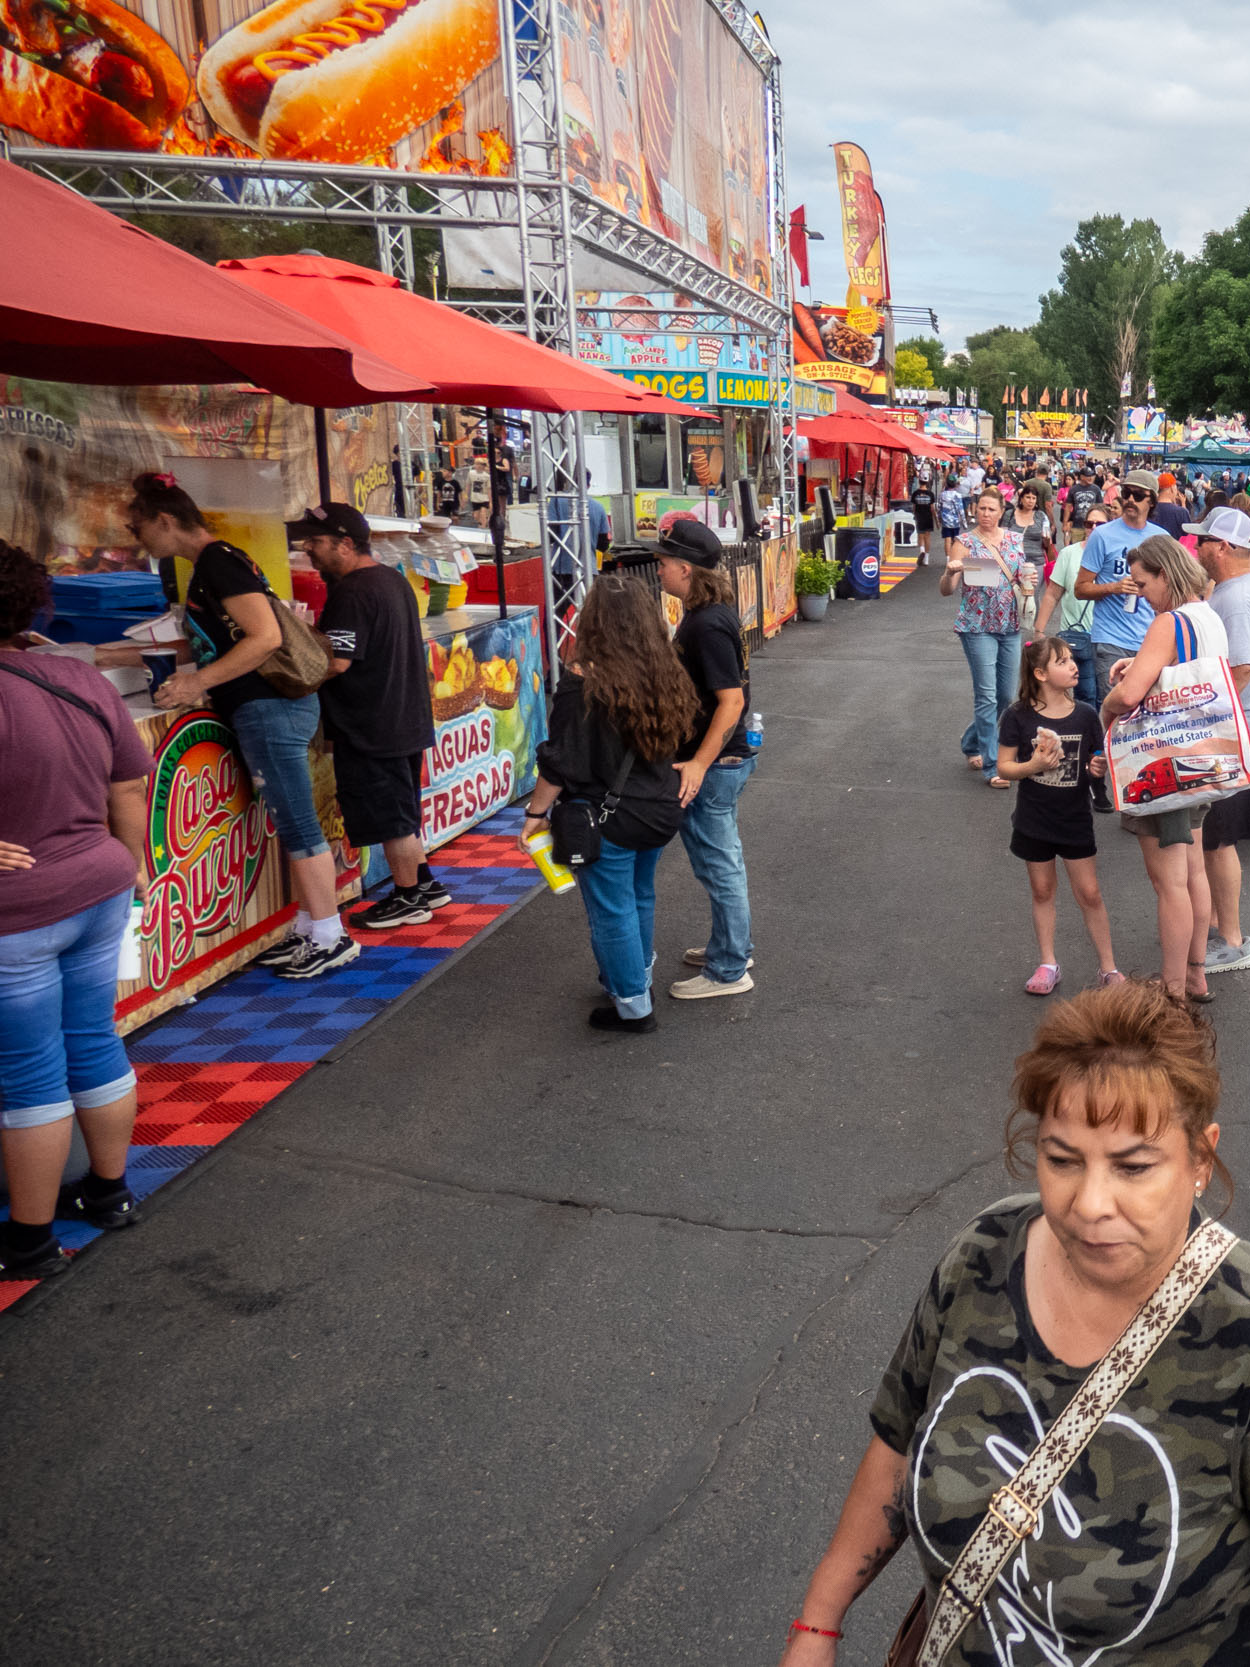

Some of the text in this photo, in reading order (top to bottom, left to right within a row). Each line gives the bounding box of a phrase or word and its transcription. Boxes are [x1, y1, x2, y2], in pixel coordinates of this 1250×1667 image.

[839, 150, 860, 258] TURKEY
[849, 266, 881, 287] LEGS
[644, 347, 665, 355] CANDY
[697, 338, 723, 349] BACON
[578, 351, 611, 362] NANAS
[631, 354, 669, 365] APPLES
[803, 364, 857, 375] SAUSAGE
[806, 371, 853, 381] ON-A-STICK
[7, 407, 77, 450] FRESCAS
[1035, 412, 1069, 421] CHICKEN
[354, 462, 389, 514] Cheetos
[1145, 682, 1214, 707] merican
[1111, 736, 1122, 747] We
[1122, 731, 1149, 743] deliver
[1150, 727, 1159, 736] to
[1160, 720, 1190, 734] almost
[1191, 713, 1234, 729] anywhere
[1131, 730, 1213, 754] in the United States
[432, 718, 492, 777] AGUAS
[168, 751, 239, 860] Casa
[421, 760, 512, 841] FRESCAS
